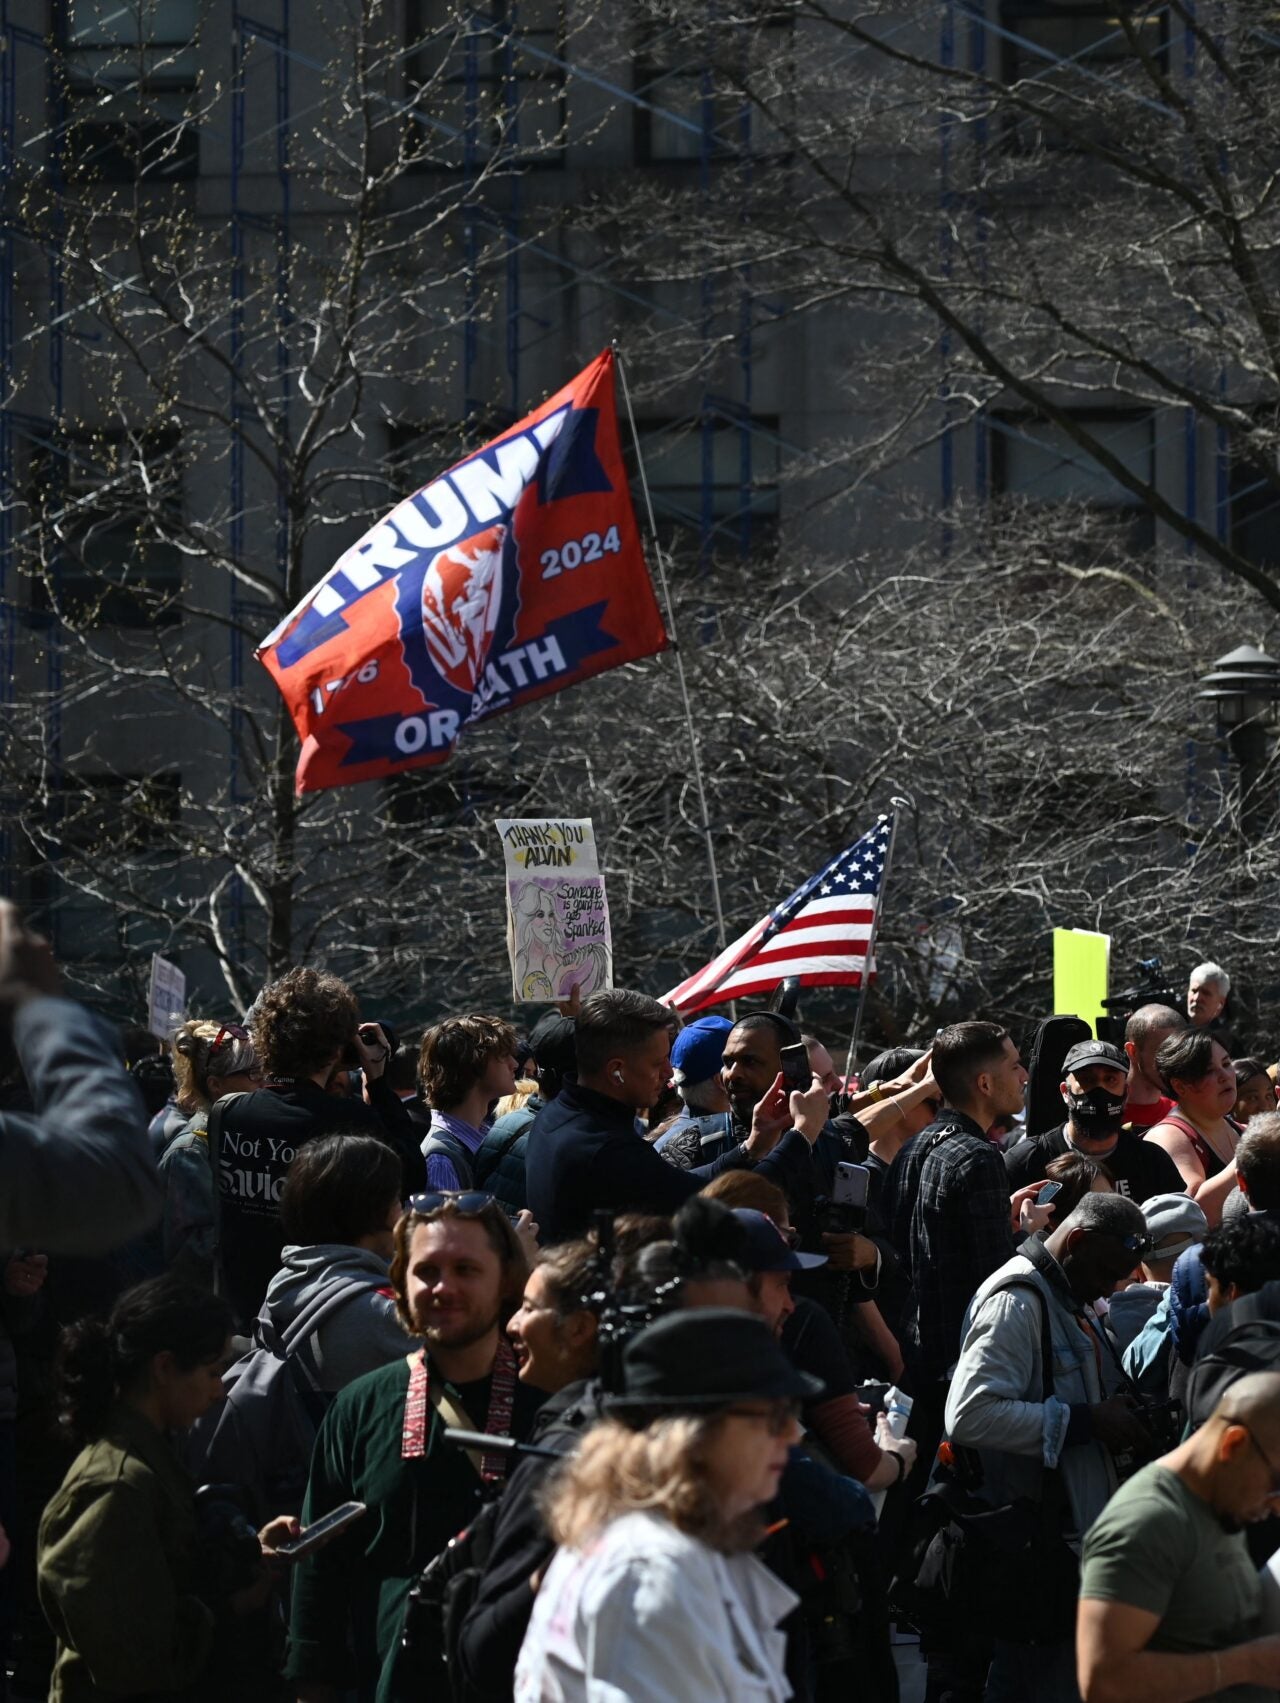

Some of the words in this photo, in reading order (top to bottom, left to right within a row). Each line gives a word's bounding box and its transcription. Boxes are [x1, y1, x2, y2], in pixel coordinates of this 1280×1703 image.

[540, 526, 621, 580] 2024
[394, 708, 461, 755] OR
[504, 822, 556, 848] THANK
[554, 822, 583, 846] YOU
[557, 883, 603, 899] Someone
[573, 899, 593, 915] going
[593, 901, 604, 910] to
[222, 1131, 262, 1158] Not
[266, 1137, 299, 1164] Yo
[219, 1160, 289, 1202] Savio
